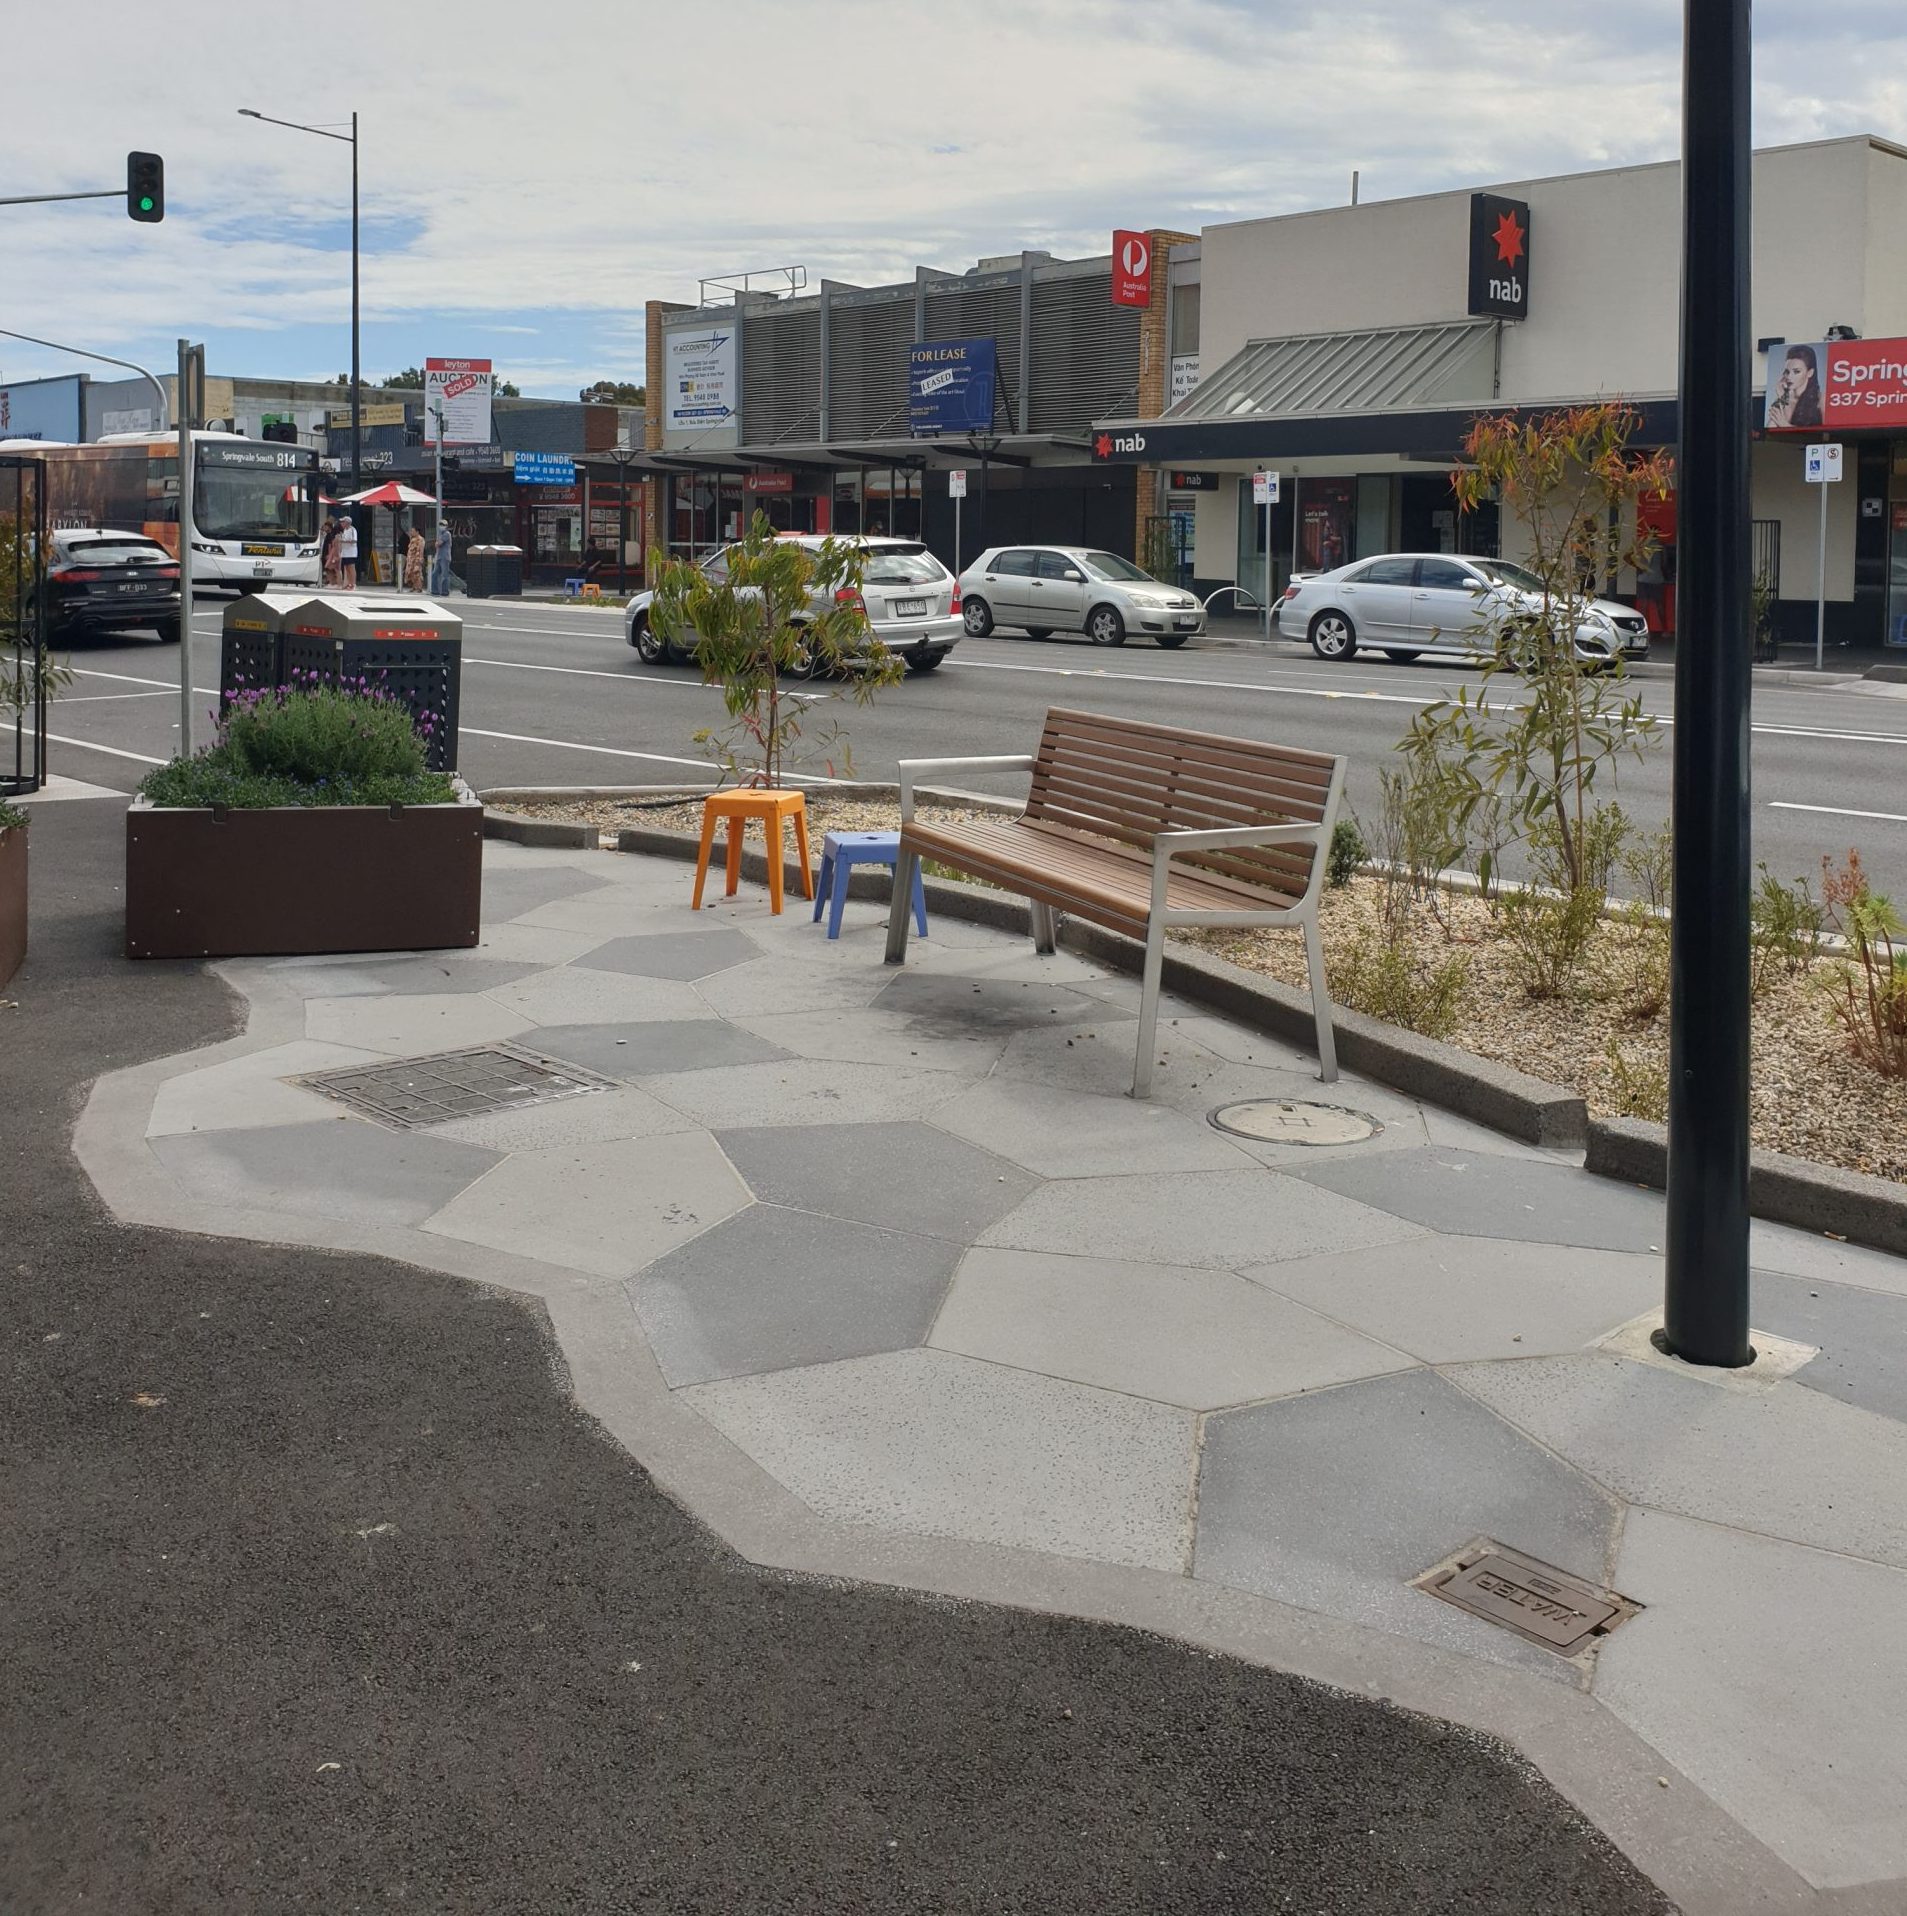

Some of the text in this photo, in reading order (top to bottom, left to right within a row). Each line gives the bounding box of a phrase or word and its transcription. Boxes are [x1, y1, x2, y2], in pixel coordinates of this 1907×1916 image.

[1123, 281, 1147, 292] Australia
[1489, 276, 1522, 303] nab
[1123, 290, 1135, 298] Post
[679, 343, 711, 352] ACCOUNTING
[912, 347, 967, 363] FOR LEASE
[444, 360, 471, 369] leyton
[429, 372, 488, 384] AUCTON
[921, 372, 951, 391] LEASED
[447, 378, 472, 394] SOLD
[1172, 388, 1187, 397] Khai
[1829, 392, 1862, 407] 337
[1115, 432, 1146, 453] nab
[222, 450, 296, 468] Springvale South 814
[515, 452, 535, 463] COIN
[1186, 474, 1202, 485] nab
